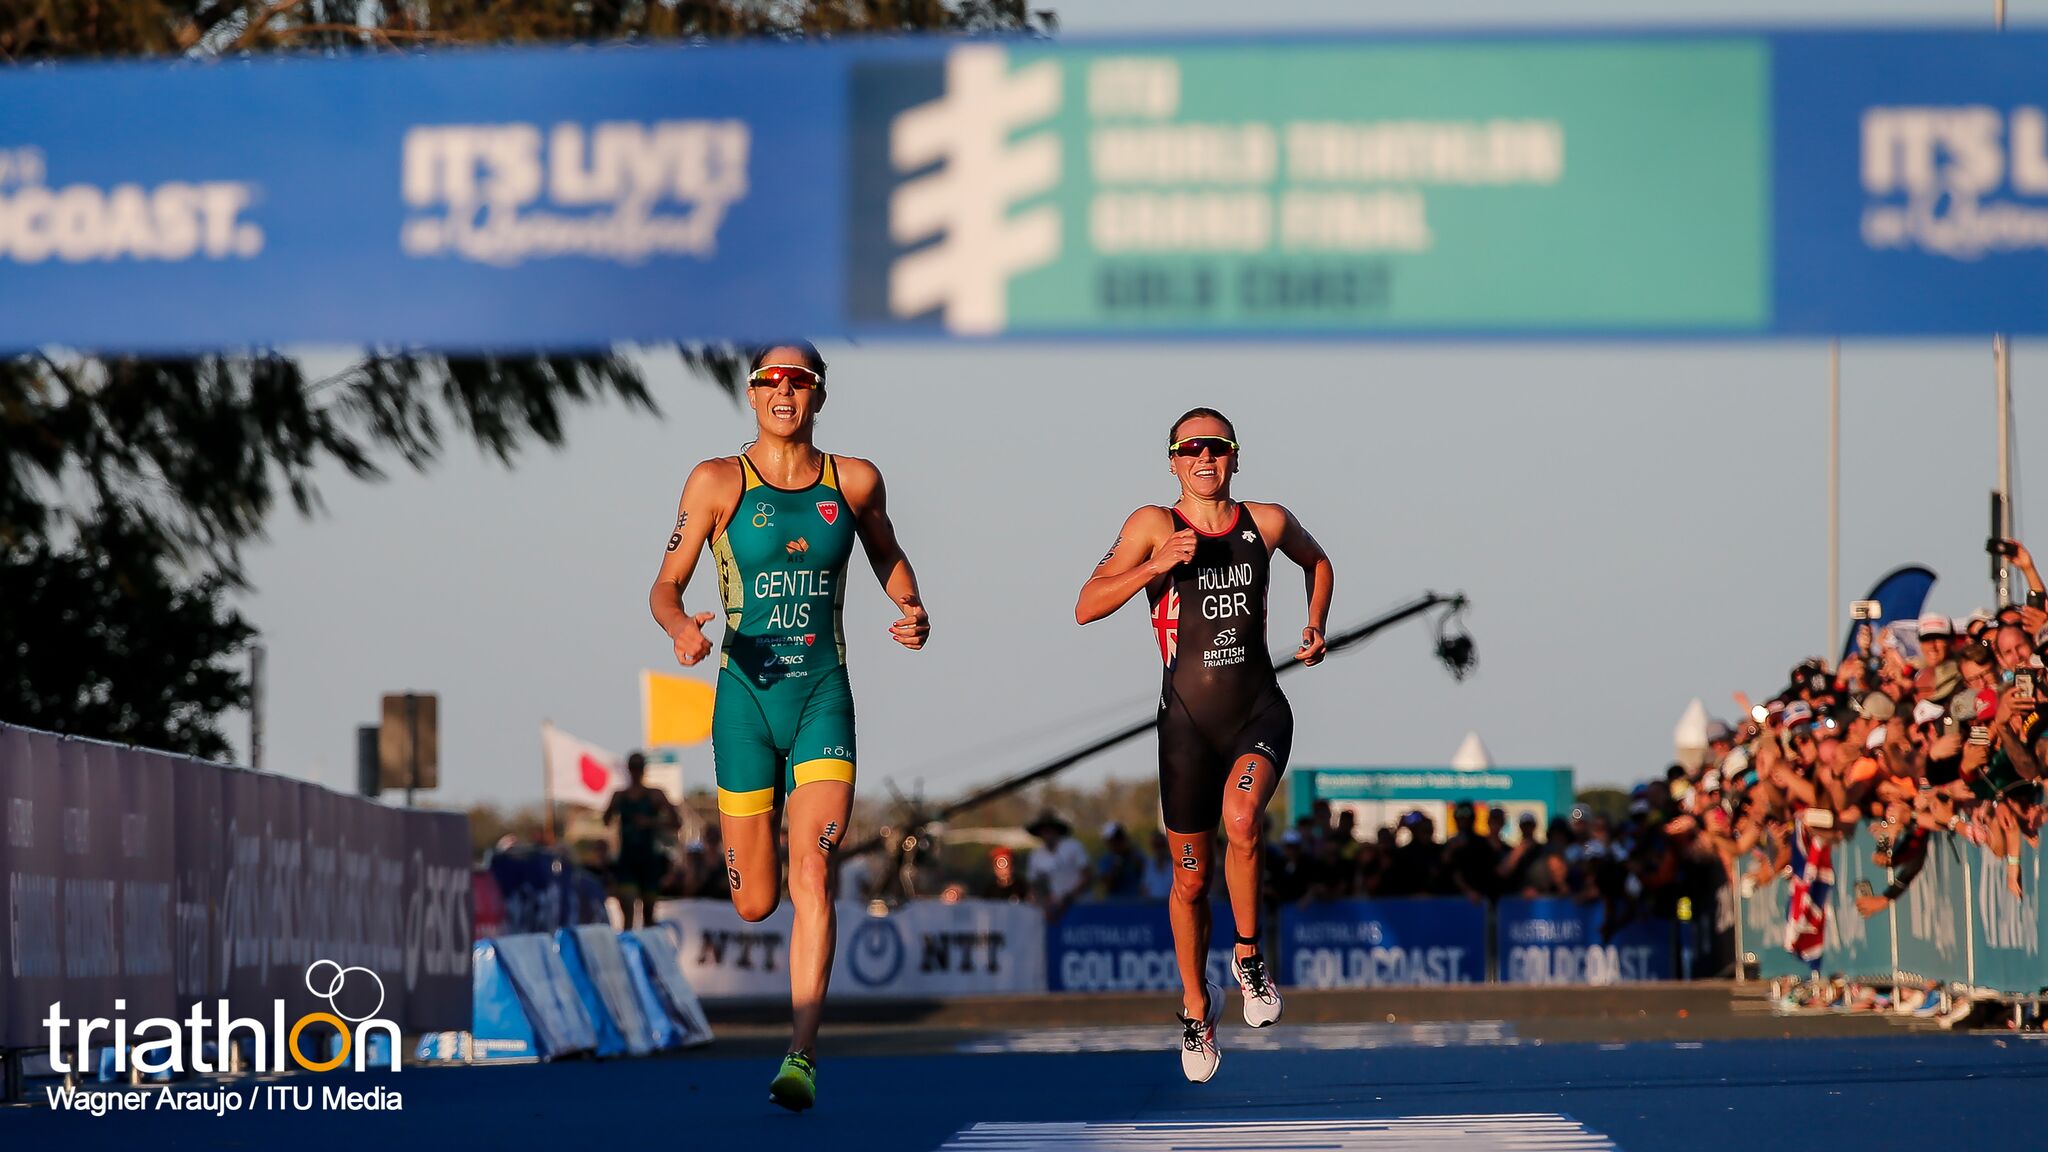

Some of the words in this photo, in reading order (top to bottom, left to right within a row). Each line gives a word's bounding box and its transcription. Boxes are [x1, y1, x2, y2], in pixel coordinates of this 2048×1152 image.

[787, 554, 805, 563] AIS
[755, 570, 829, 599] GENTLE
[1198, 563, 1252, 590] HOLLAND
[766, 603, 810, 630] AUS
[1202, 592, 1250, 620] GBR
[1203, 646, 1245, 660] BRITISH
[1203, 656, 1245, 668] TRIATHLON
[1237, 774, 1254, 792] 2
[1181, 857, 1198, 872] 2
[699, 929, 785, 973] NTT
[920, 931, 1004, 973] NTT
